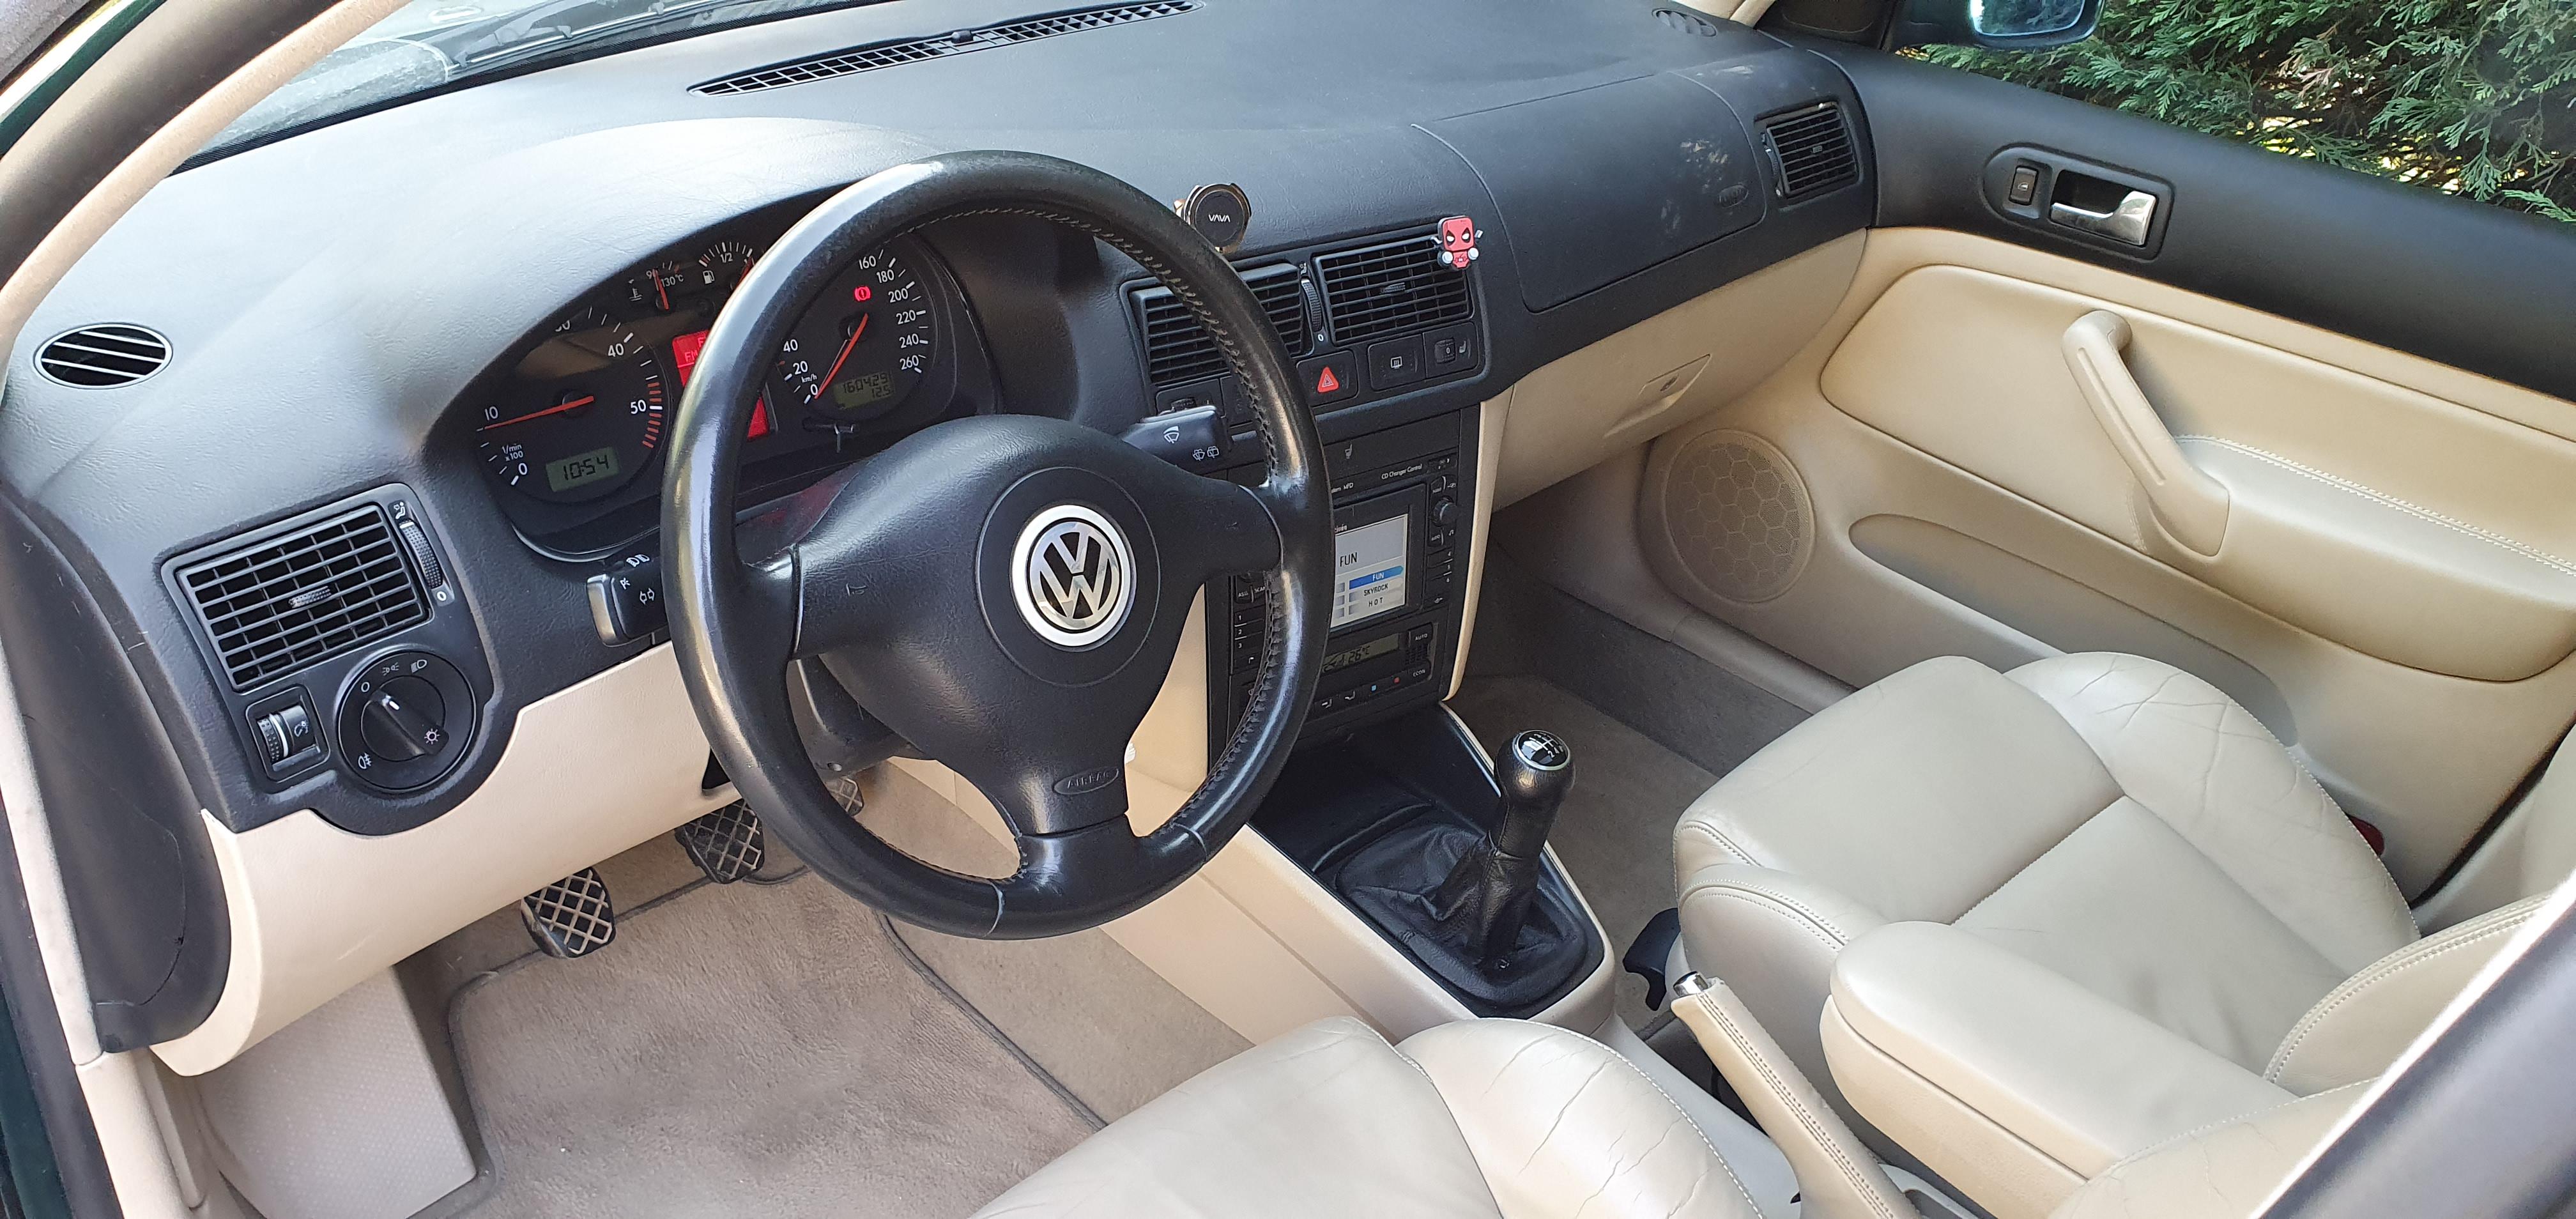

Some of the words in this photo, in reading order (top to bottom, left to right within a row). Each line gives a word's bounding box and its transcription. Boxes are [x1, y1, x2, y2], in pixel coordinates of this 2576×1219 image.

[1208, 213, 1230, 223] VAVA
[721, 252, 733, 263] 1/2
[859, 255, 877, 270] 160
[876, 269, 894, 284] 180
[888, 288, 909, 303] 200
[896, 309, 916, 325] 220
[783, 339, 798, 353] 40
[899, 333, 919, 349] 240
[608, 342, 624, 358] 40
[792, 360, 808, 375] 20
[900, 355, 919, 370] 260
[801, 374, 818, 384] km/h
[484, 406, 499, 421] 10
[630, 399, 647, 415] 50
[502, 443, 523, 454] 1/min
[518, 463, 528, 475] 0
[563, 454, 610, 480] 10:54
[1340, 551, 1358, 567] FUN
[1372, 572, 1384, 582] FUN
[1547, 750, 1555, 758] 2
